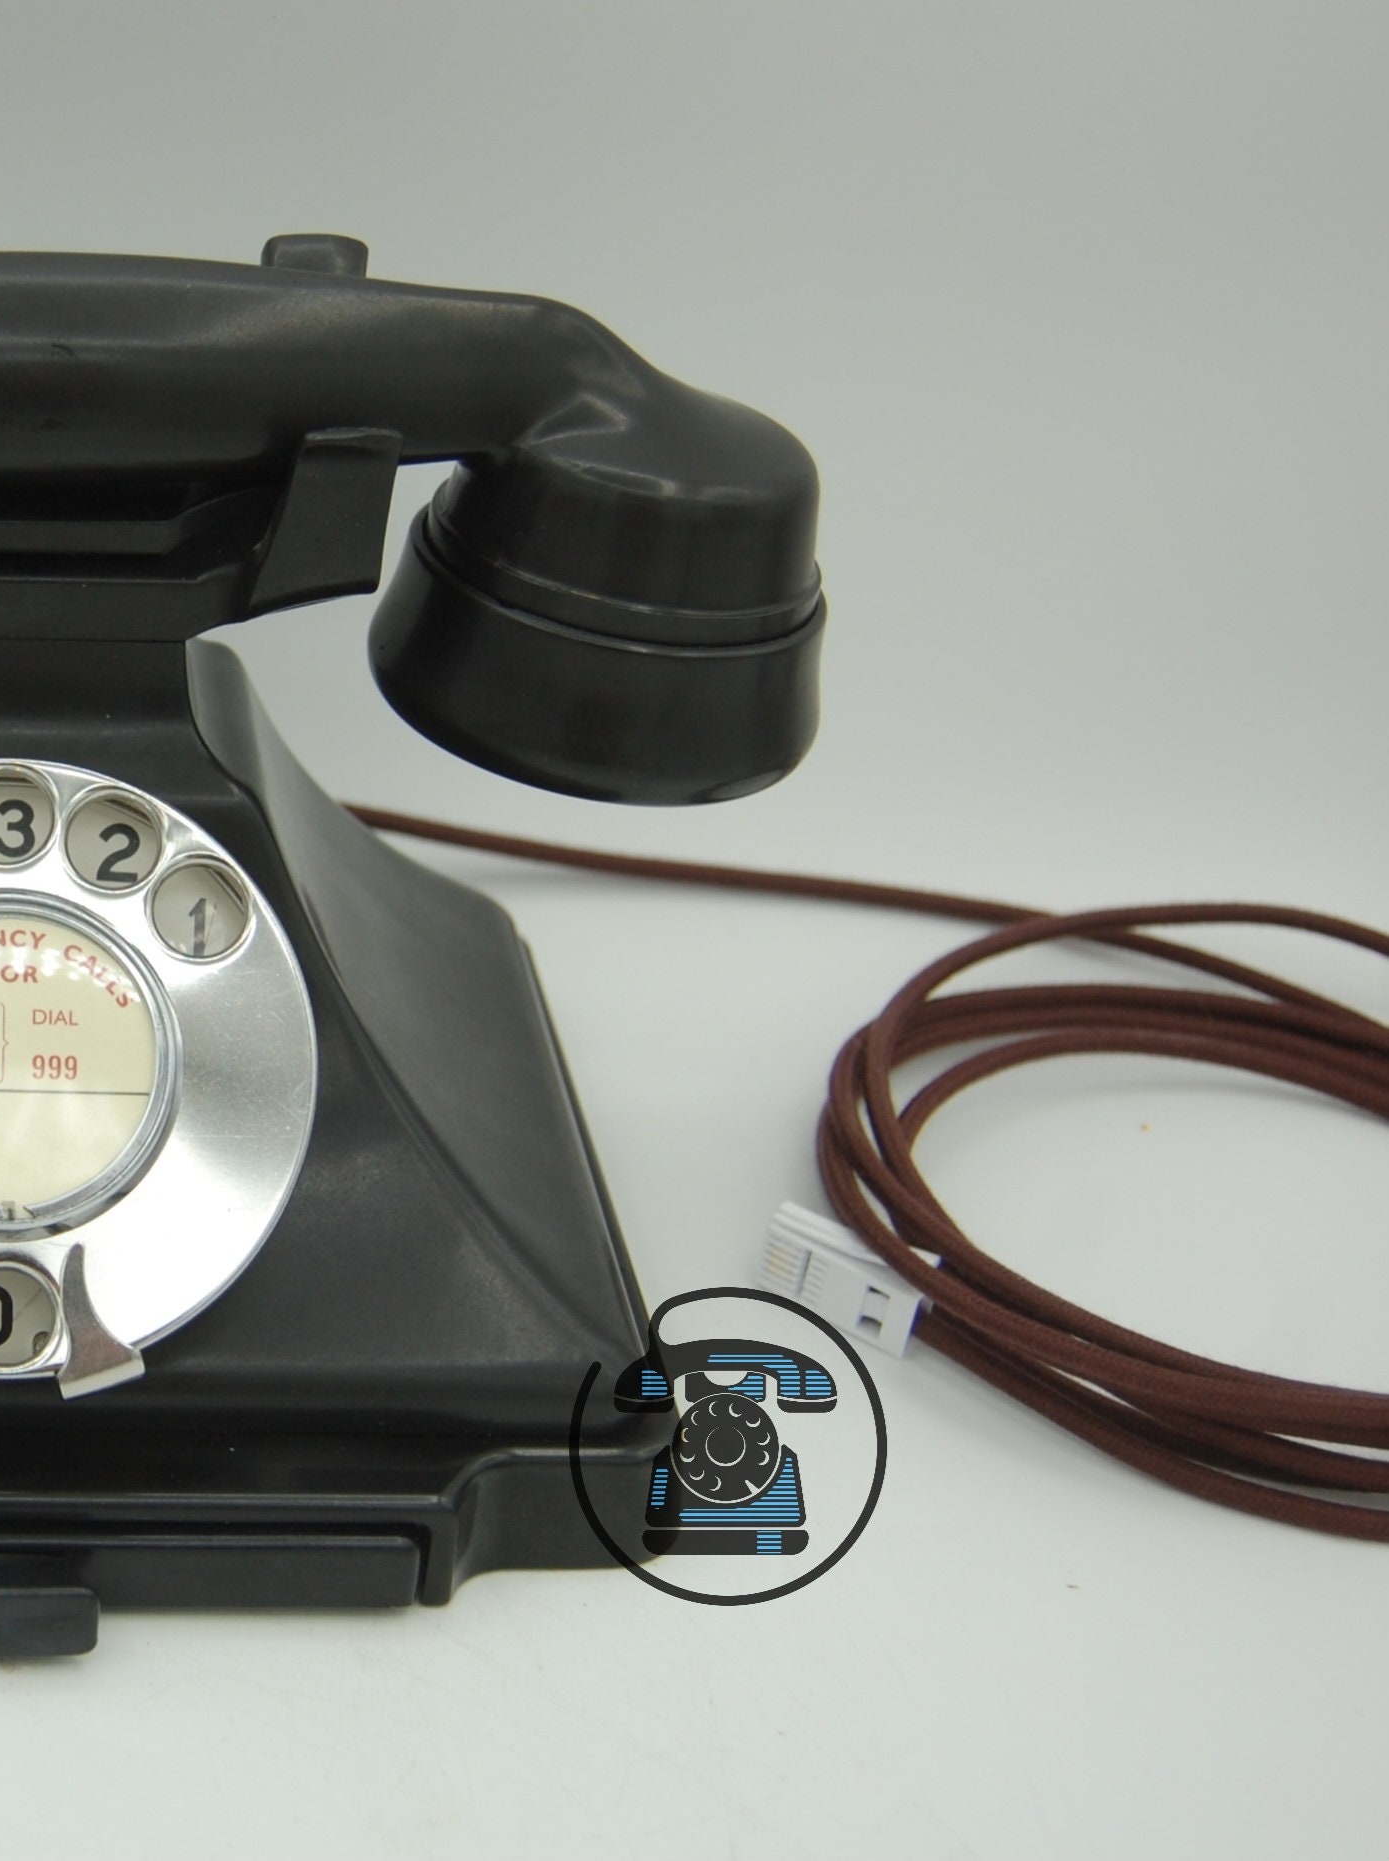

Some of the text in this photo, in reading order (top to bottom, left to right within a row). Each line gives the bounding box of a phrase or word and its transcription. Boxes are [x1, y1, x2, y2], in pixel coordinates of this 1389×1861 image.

[96, 822, 141, 883] 2
[188, 897, 207, 957] 1
[63, 944, 133, 1008] CALLS
[31, 1008, 79, 1026] DIAL
[31, 1054, 78, 1081] 999
